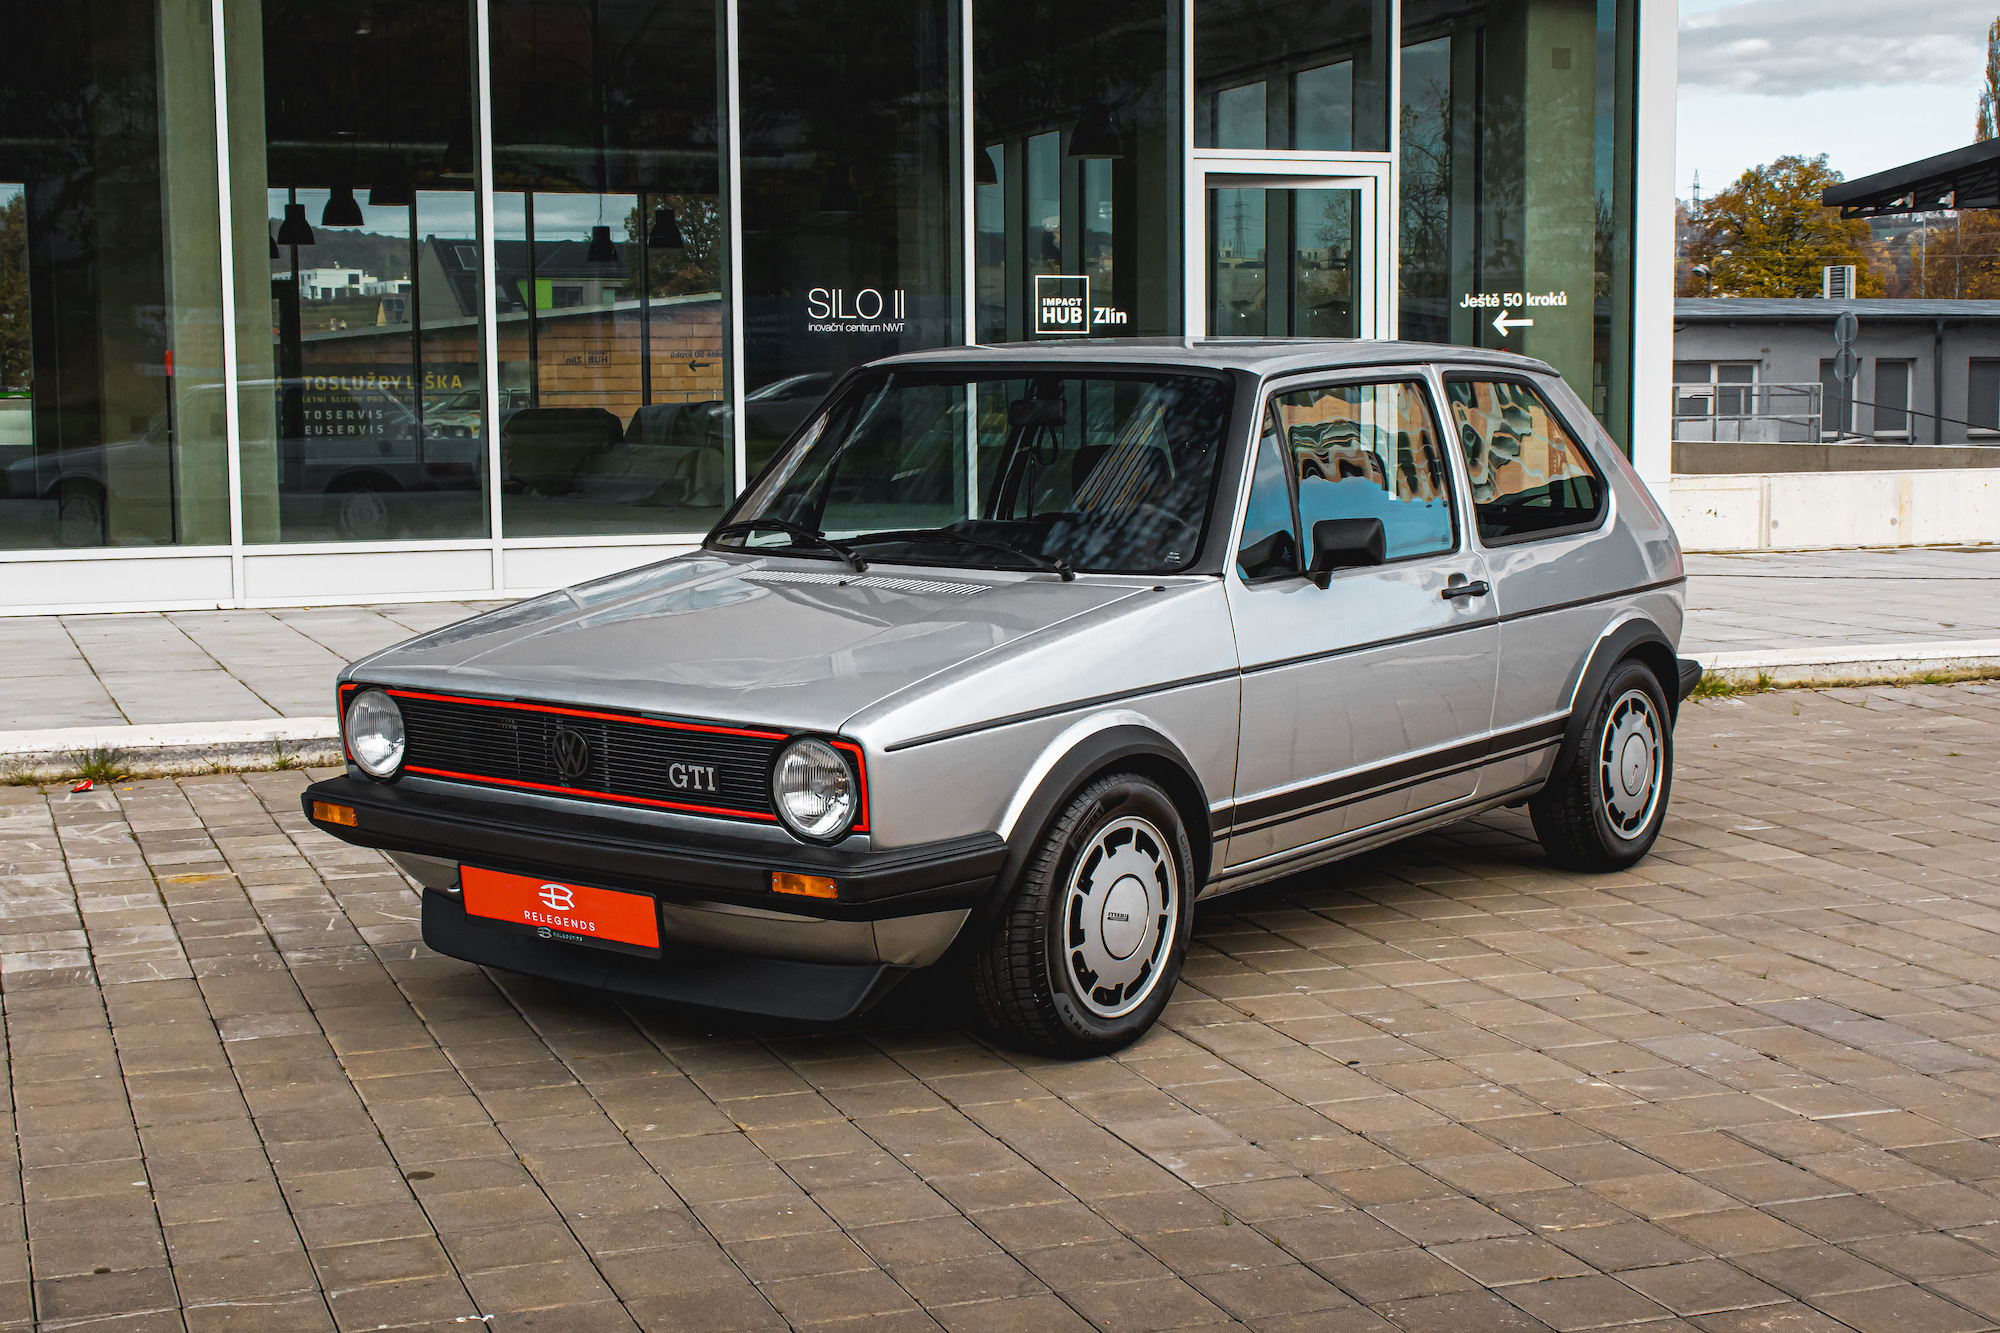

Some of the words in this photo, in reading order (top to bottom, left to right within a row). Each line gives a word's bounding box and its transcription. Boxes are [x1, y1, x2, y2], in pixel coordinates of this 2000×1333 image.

[807, 287, 883, 320] SILO
[894, 289, 905, 319] II
[1042, 297, 1082, 306] IMPACT
[1459, 293, 1500, 308] Ještě
[1503, 292, 1523, 307] 50
[1526, 291, 1567, 306] kroků
[1042, 307, 1082, 324] HUB
[1093, 307, 1127, 324] Zlín
[808, 322, 844, 332] inovační
[845, 323, 881, 333] centrum
[883, 323, 905, 333] NWT
[406, 371, 463, 390] LŠKA
[281, 409, 383, 420] TOSERVIS
[281, 425, 385, 435] EUSERVIS
[668, 762, 717, 792] GTI
[523, 910, 596, 932] RELEGENDS
